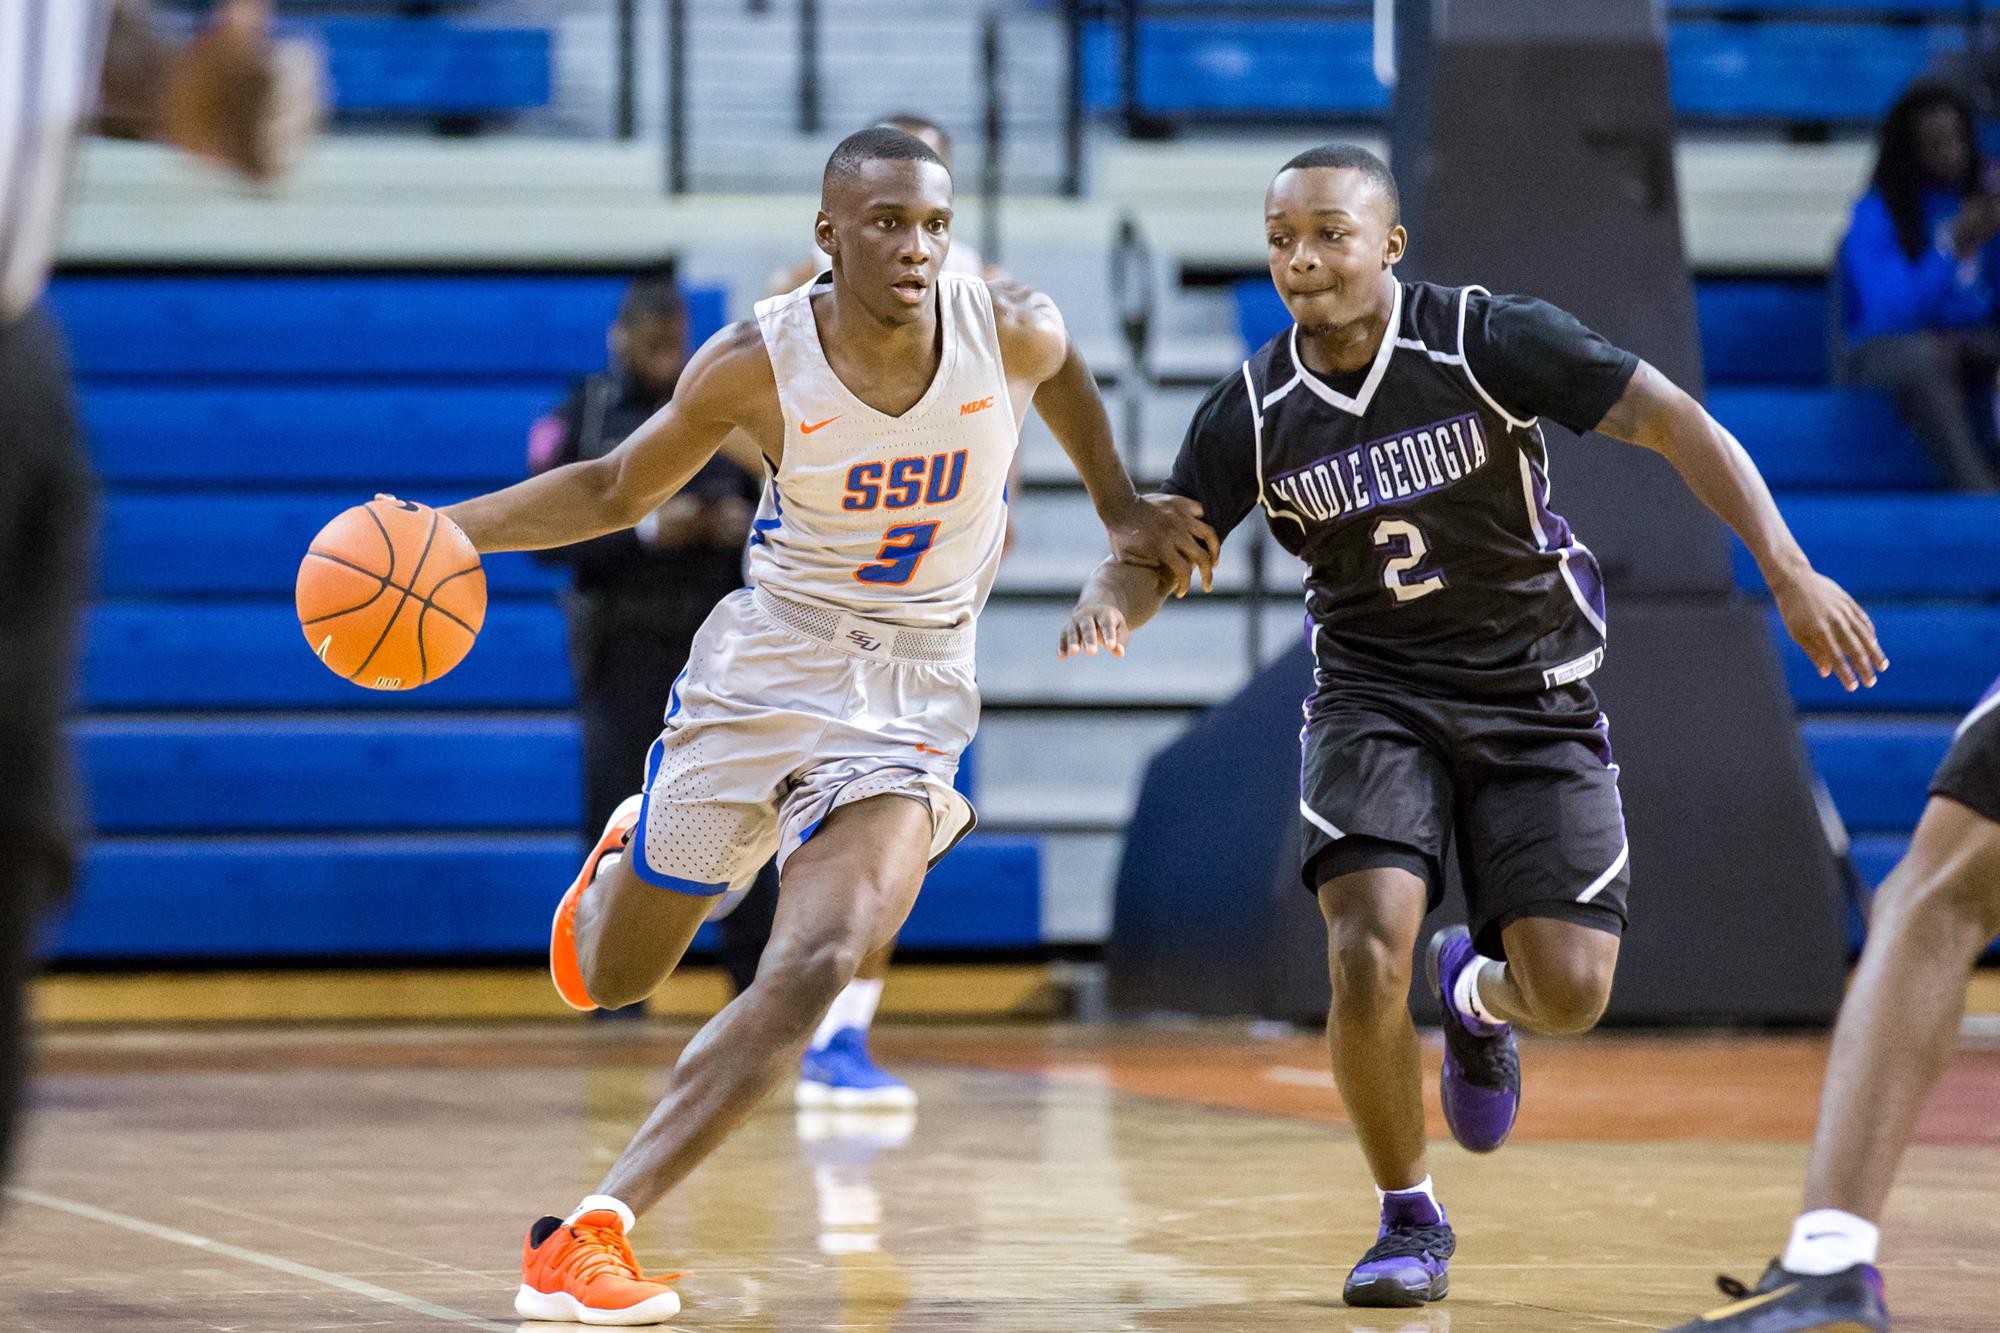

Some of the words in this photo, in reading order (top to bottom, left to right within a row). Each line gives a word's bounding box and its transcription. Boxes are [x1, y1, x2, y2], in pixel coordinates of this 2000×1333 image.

[960, 395, 994, 416] MEAC
[841, 449, 968, 512] SSU
[1369, 417, 1488, 500] GEORGIA
[853, 520, 941, 586] 3
[1373, 519, 1446, 602] 2
